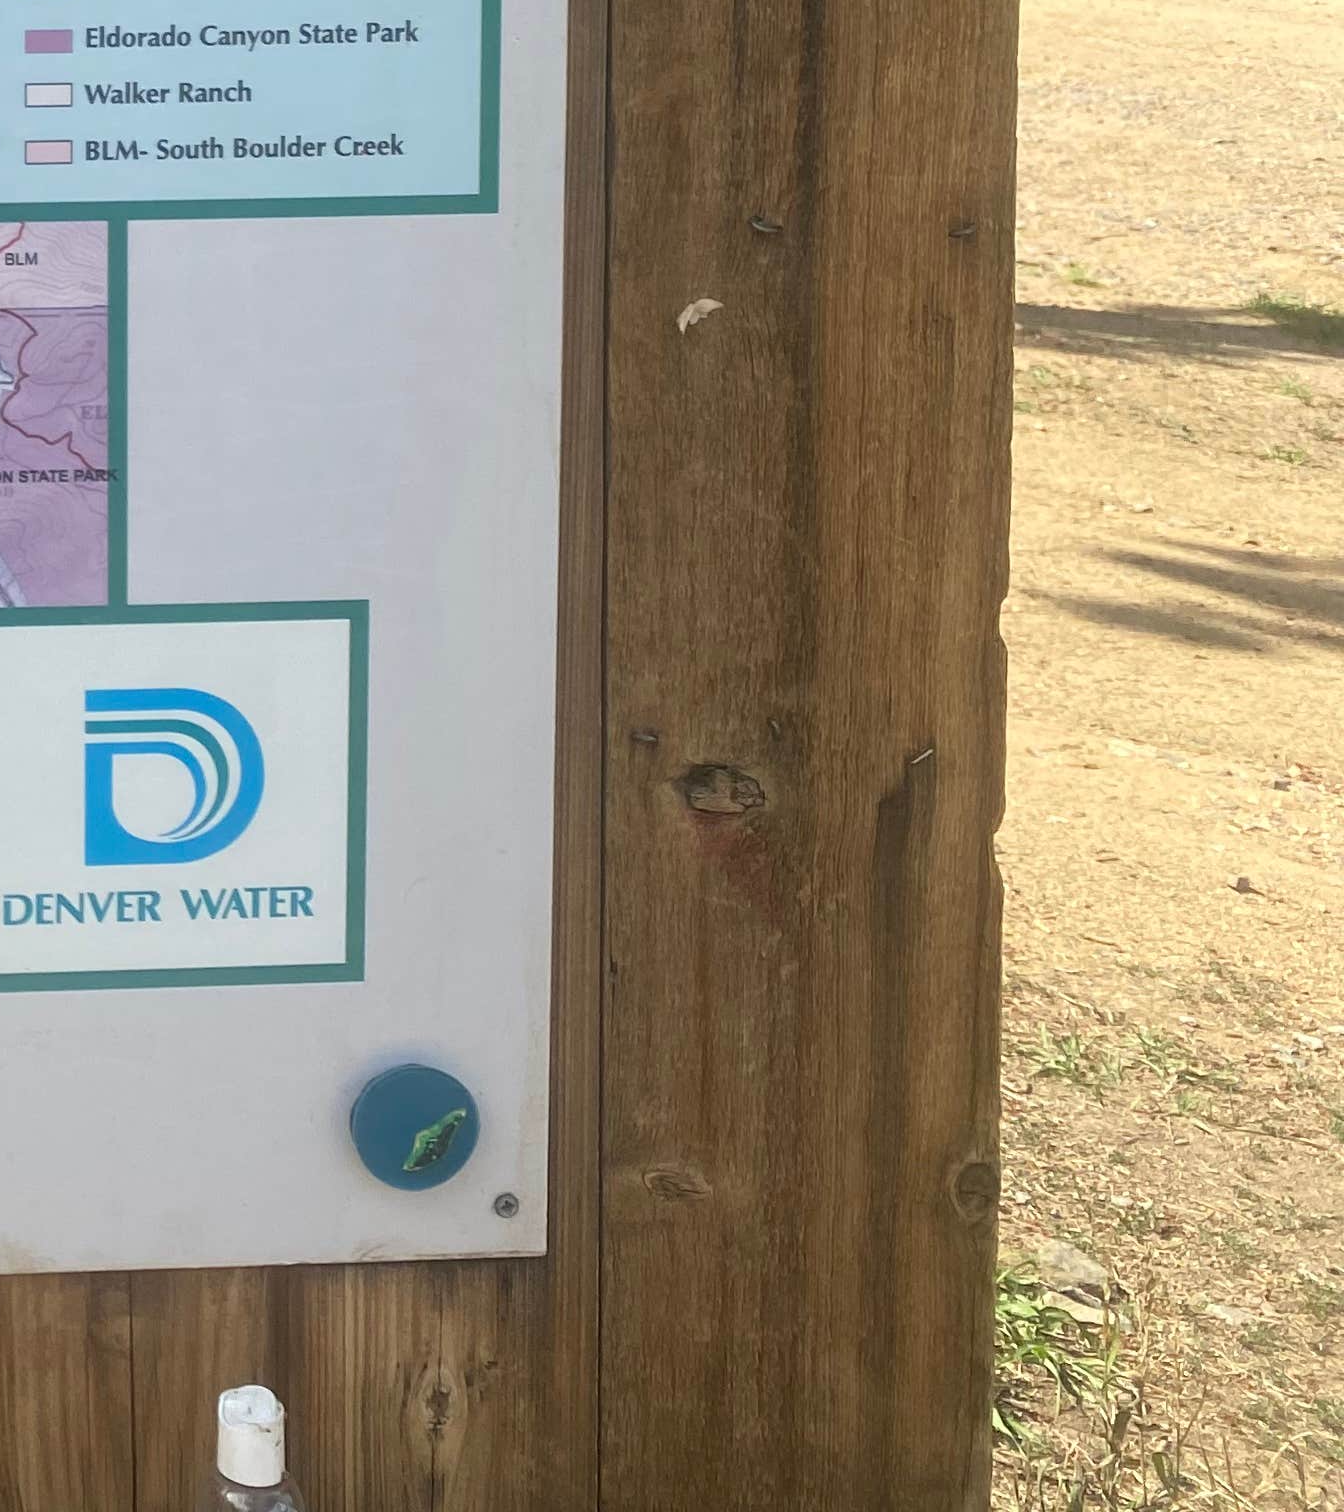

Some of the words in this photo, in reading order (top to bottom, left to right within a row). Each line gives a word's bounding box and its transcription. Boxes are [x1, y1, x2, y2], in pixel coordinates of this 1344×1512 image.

[86, 24, 191, 48] Eldorado
[200, 25, 290, 51] Canyon
[299, 24, 357, 44] State
[367, 20, 418, 42] Park
[84, 82, 170, 104] Walker
[179, 80, 251, 102] Ranch
[86, 141, 148, 160] BLM-
[157, 137, 223, 160] South
[234, 135, 326, 158] Boulder
[334, 133, 403, 156] Creek
[4, 891, 161, 925] DENVER
[180, 886, 313, 919] WATER
